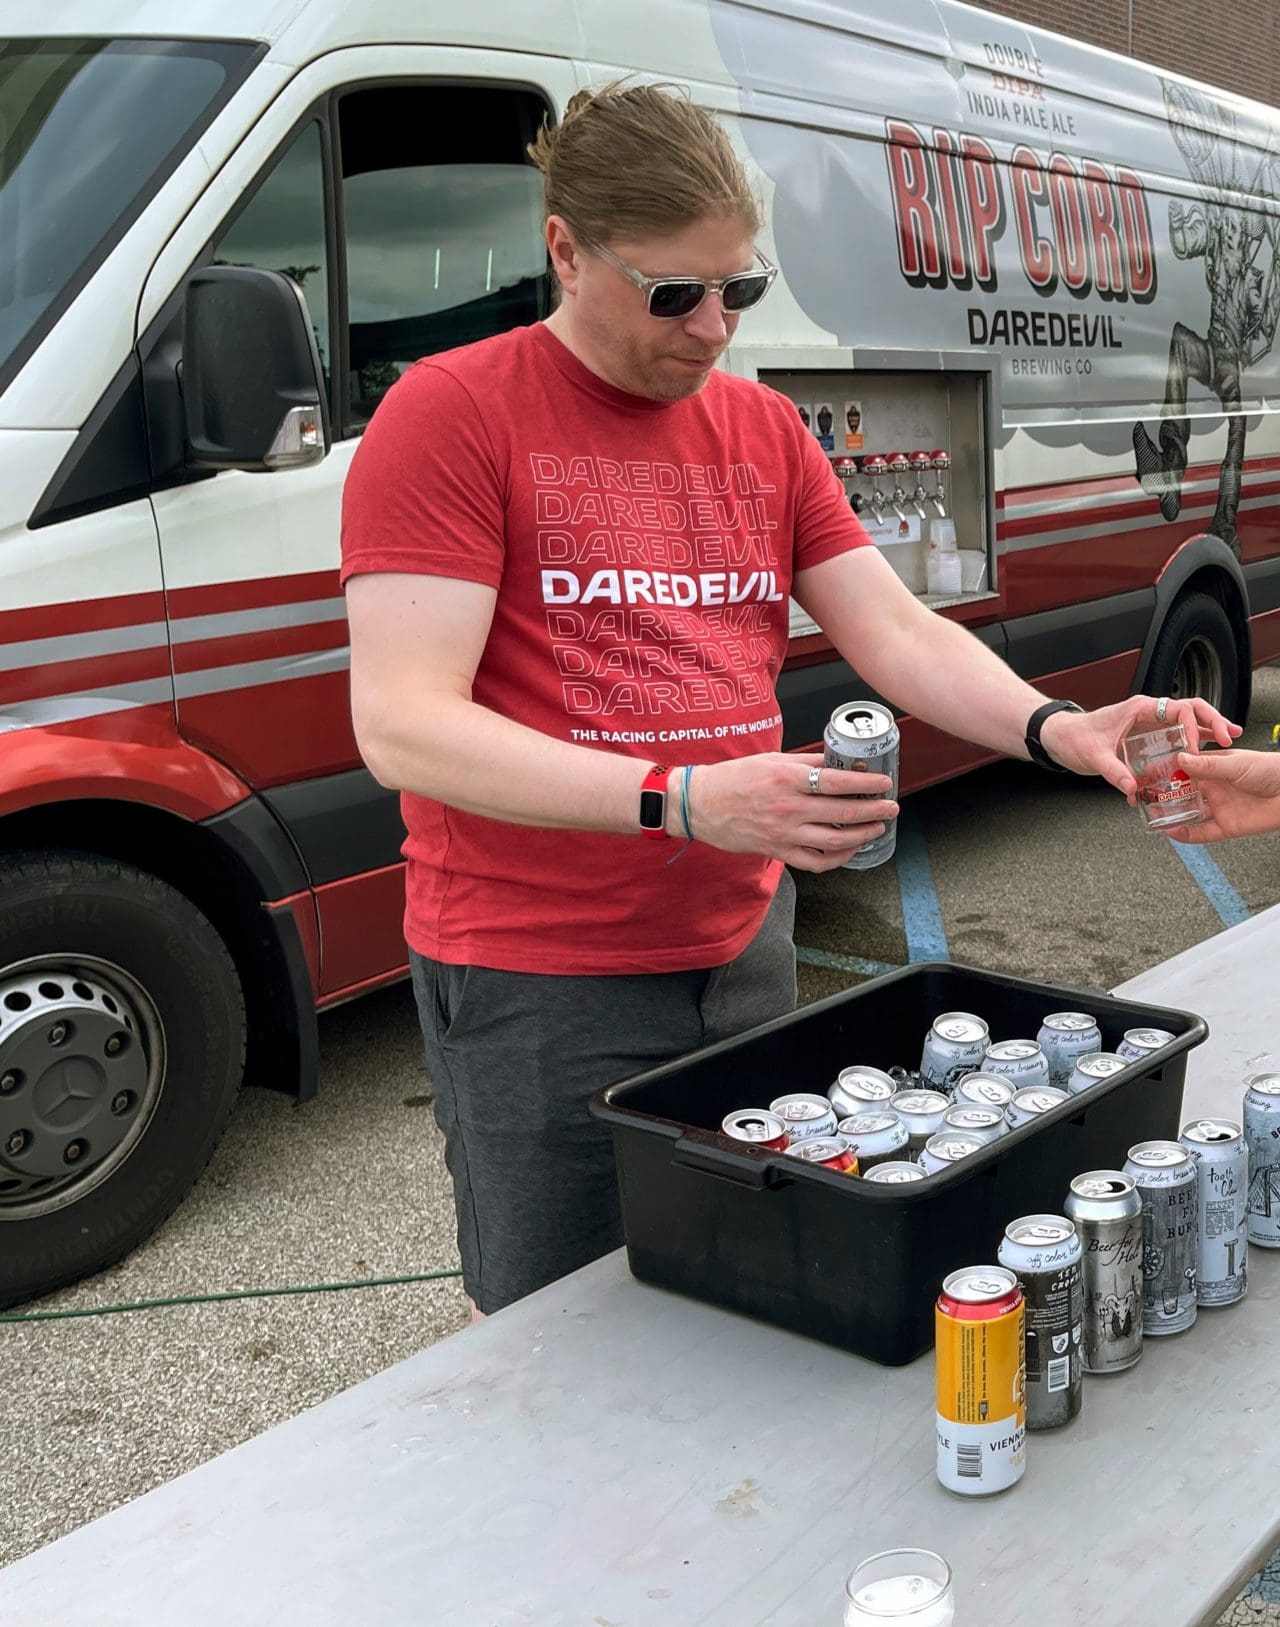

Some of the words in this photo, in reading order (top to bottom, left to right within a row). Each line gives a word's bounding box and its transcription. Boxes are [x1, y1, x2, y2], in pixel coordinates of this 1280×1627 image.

[983, 43, 1044, 78] DOUBLE
[967, 90, 1010, 121] INDIA
[1013, 102, 1048, 129] PALE
[1052, 112, 1077, 136] ALE
[885, 116, 1007, 293] RIP
[1008, 144, 1157, 304] CORD
[967, 308, 1122, 348] DAREDEVIL
[1012, 359, 1072, 376] BREWING
[1076, 360, 1092, 375] CO
[530, 453, 776, 496] DAREDEVIL
[536, 490, 778, 531] DAREDEVIL
[537, 530, 778, 568] DAREDEVIL
[541, 569, 784, 607] DAREDEVIL
[546, 604, 772, 642] DAREDEVIL
[571, 728, 599, 741] THE
[601, 730, 655, 743] RACING
[658, 728, 712, 742] CAPITAL
[714, 725, 728, 737] OF
[730, 723, 748, 736] THE
[963, 1045, 981, 1057] color
[1062, 1034, 1079, 1043] color
[996, 1065, 1015, 1075] color
[1018, 1059, 1045, 1074] brewing
[804, 1120, 835, 1136] brewing
[1148, 1171, 1170, 1183] color
[1207, 1166, 1234, 1184] tooth
[1027, 1253, 1043, 1268] off
[1044, 1249, 1067, 1262] color
[1088, 1239, 1115, 1252] Beer
[1100, 1225, 1133, 1267] for
